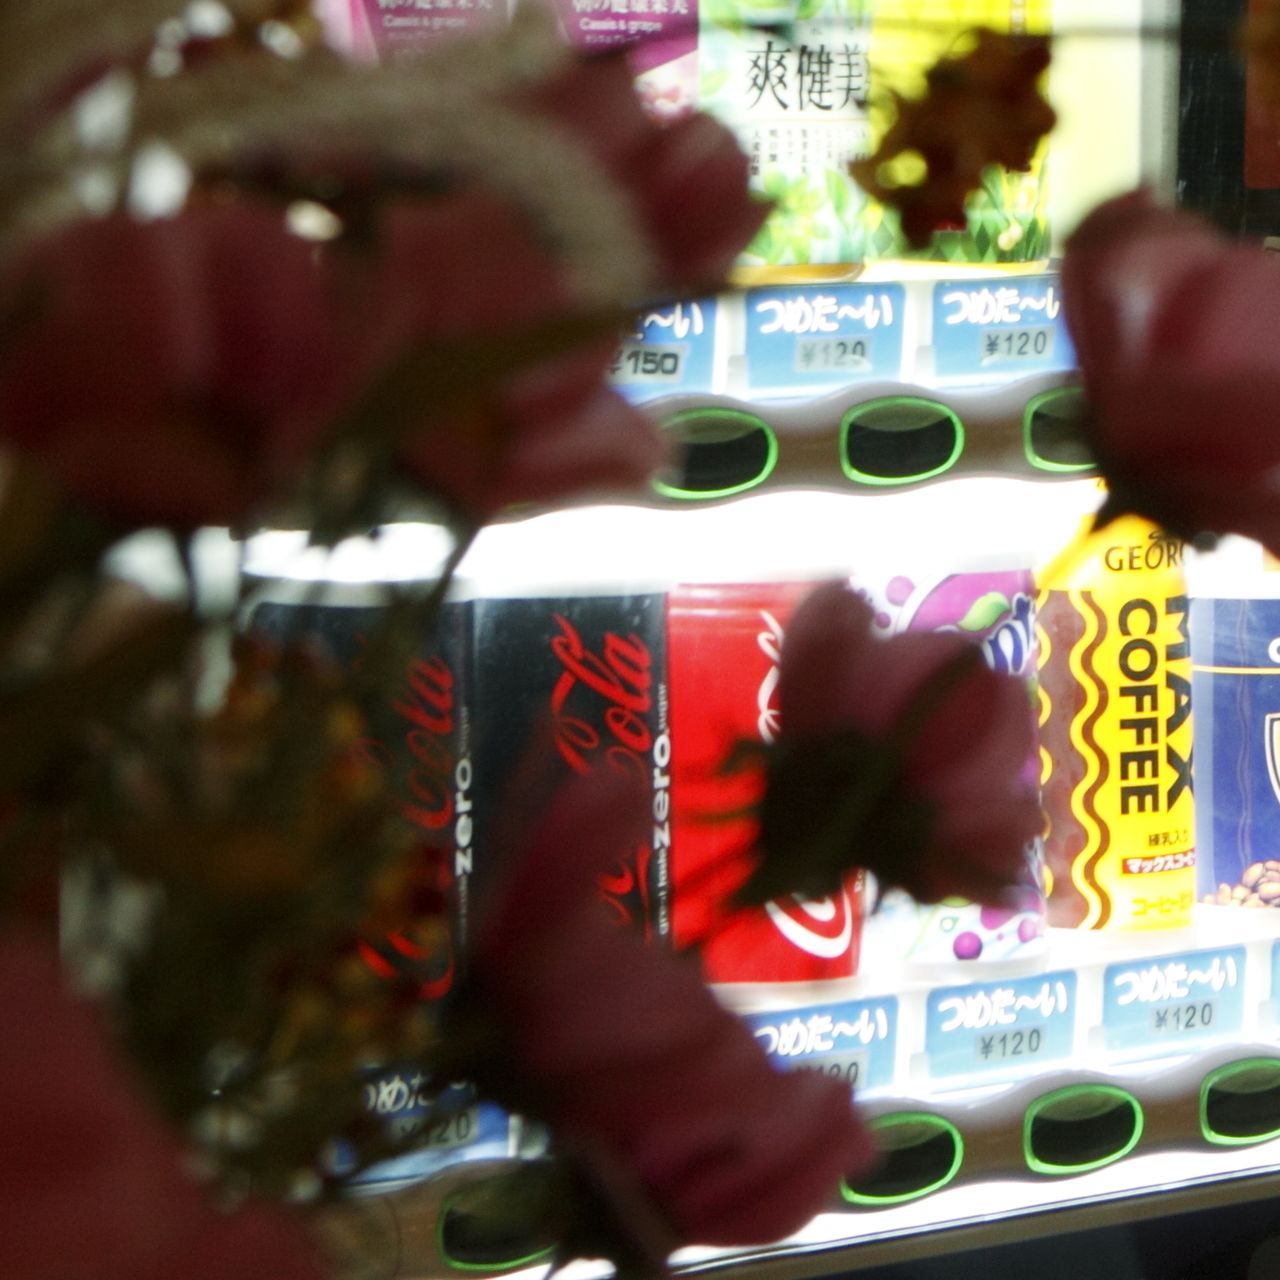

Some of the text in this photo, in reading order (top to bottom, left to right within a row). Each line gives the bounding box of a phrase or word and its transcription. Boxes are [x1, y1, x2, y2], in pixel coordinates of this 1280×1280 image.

[985, 330, 1048, 356] ¥120
[1118, 597, 1160, 816] COFFEE
[454, 758, 475, 876] zero
[653, 733, 672, 848] zero
[979, 1030, 1042, 1058] ¥120
[1155, 1004, 1215, 1031] ¥120
